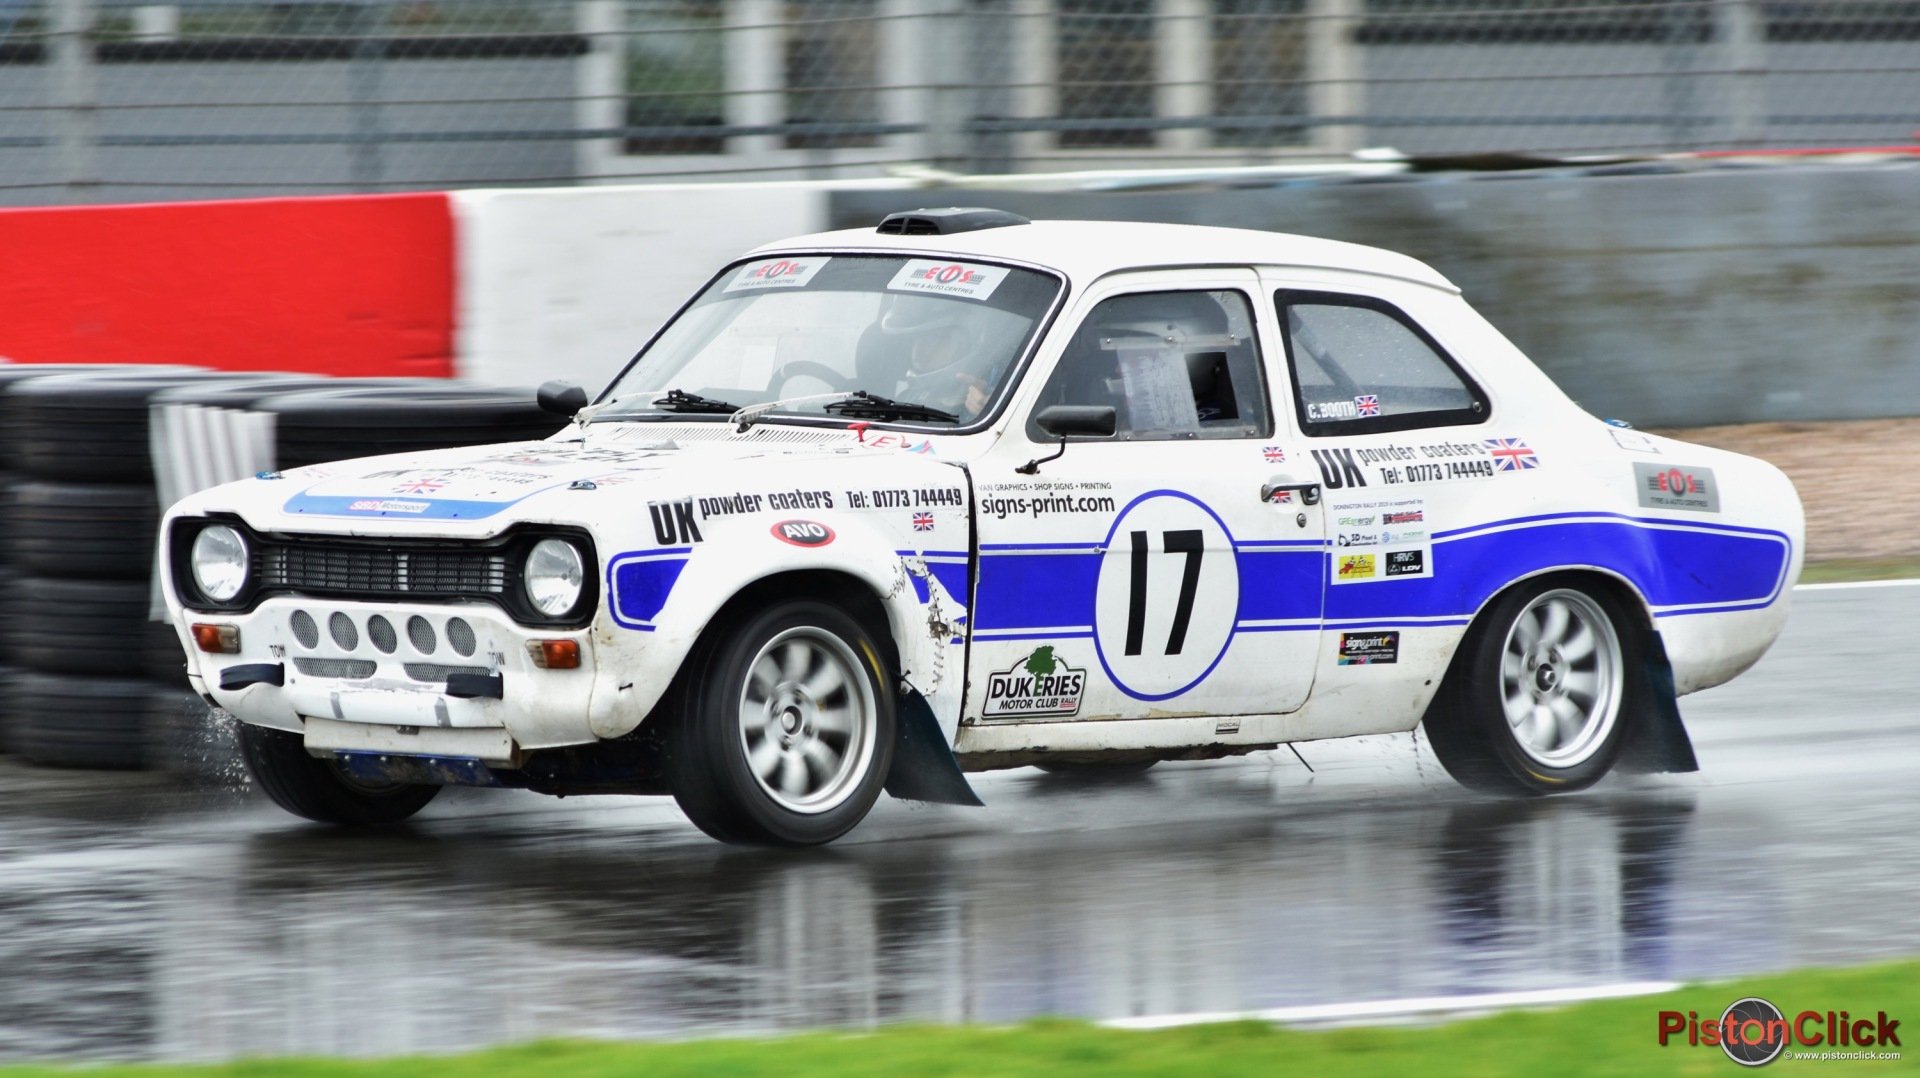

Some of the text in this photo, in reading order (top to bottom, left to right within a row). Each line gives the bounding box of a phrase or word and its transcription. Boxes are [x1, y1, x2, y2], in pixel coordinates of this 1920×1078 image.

[944, 284, 974, 294] CENTRES
[1310, 441, 1487, 489] UK powder coaters
[1380, 460, 1494, 486] Tel: 01773 744449
[979, 482, 1112, 492] VAN GRAPHICS SHOP SIGNS PRINTING
[648, 488, 963, 545] UK powder coaters Tel: 01773 744449
[981, 492, 1115, 519] signs-print.com
[782, 521, 826, 539] AVO
[1125, 529, 1204, 656] 17
[991, 674, 1082, 699] DUKERIES
[999, 698, 1059, 710] MOTOR CLUB
